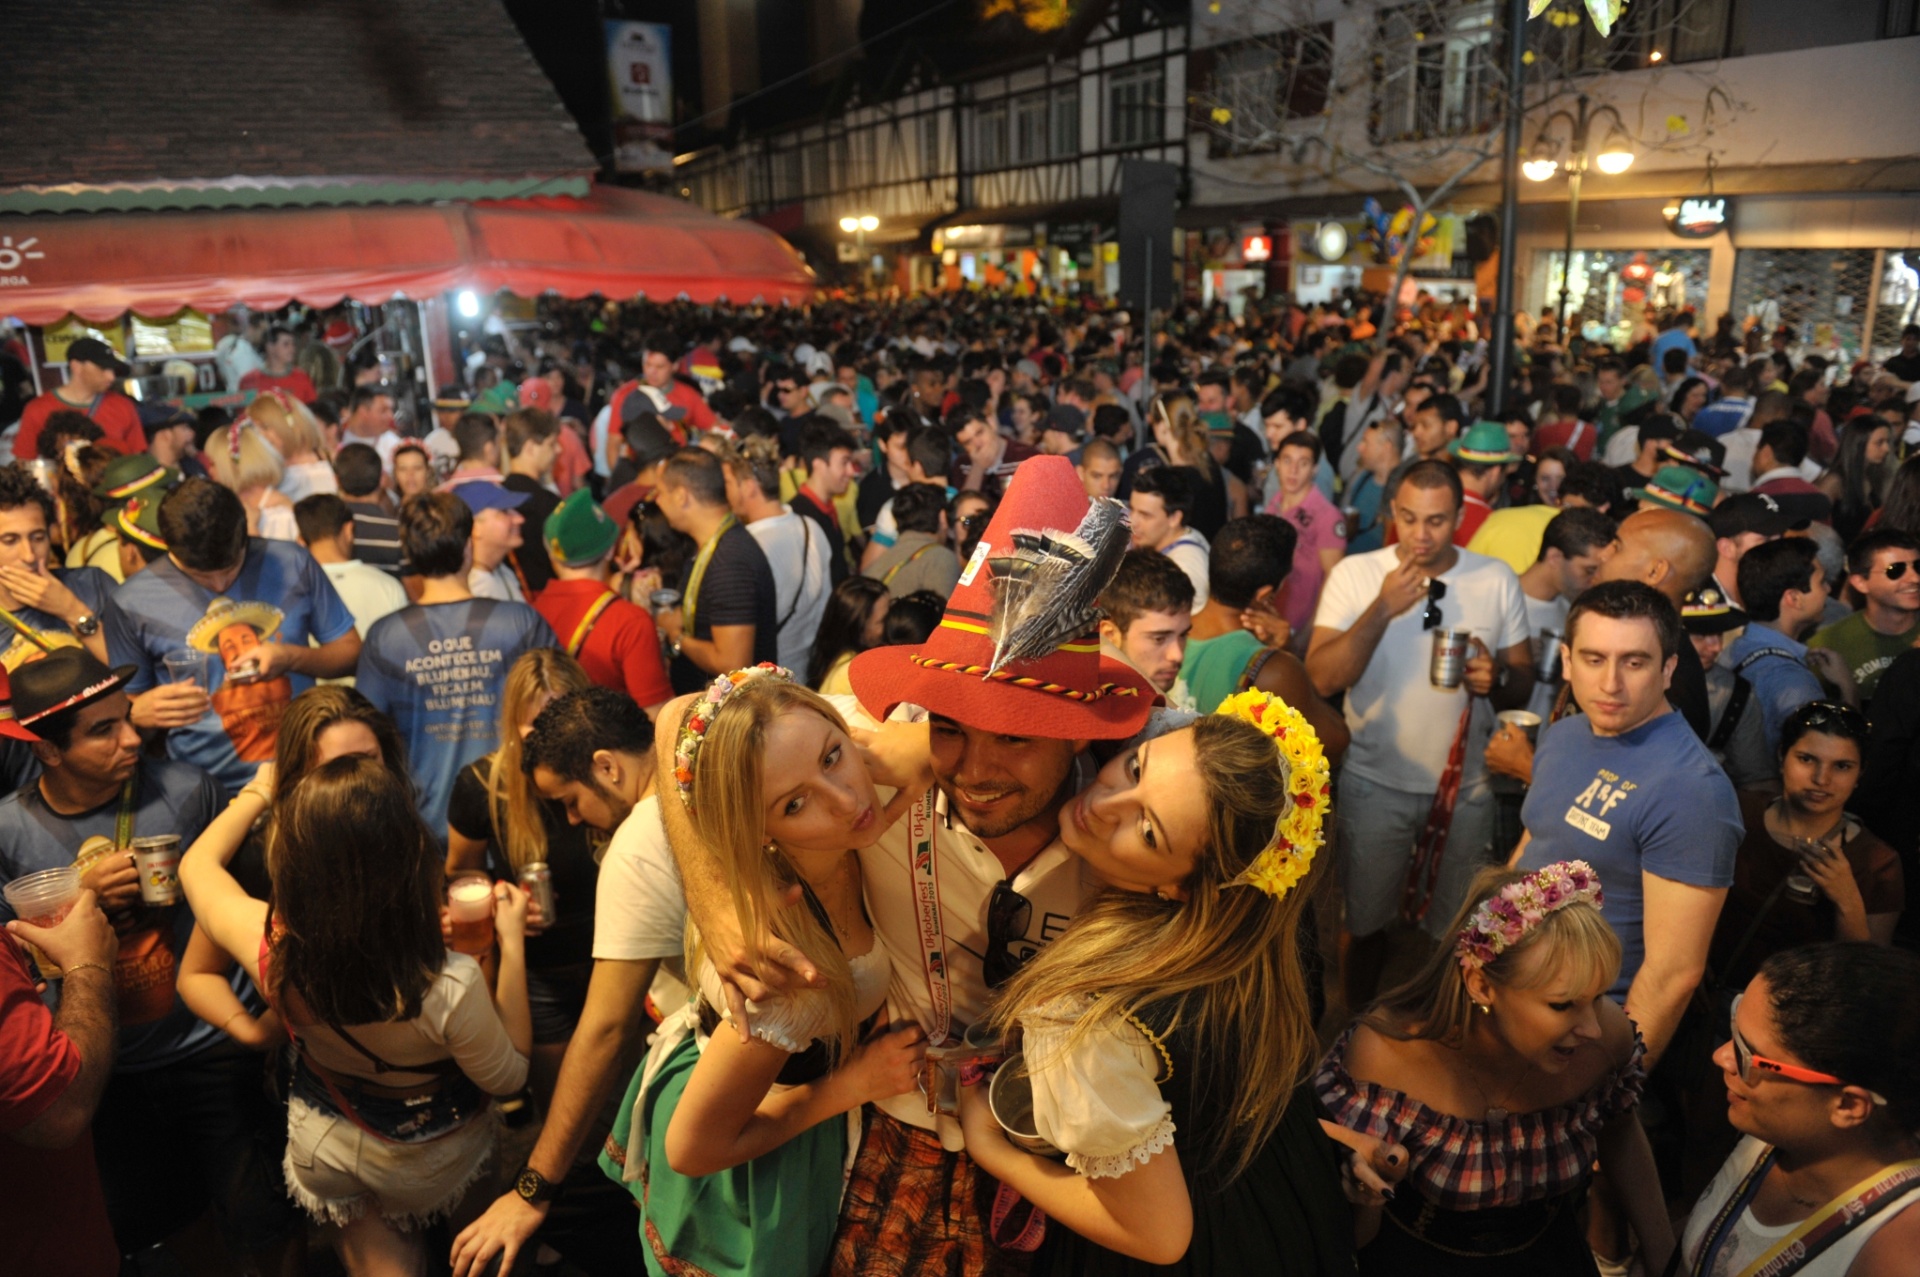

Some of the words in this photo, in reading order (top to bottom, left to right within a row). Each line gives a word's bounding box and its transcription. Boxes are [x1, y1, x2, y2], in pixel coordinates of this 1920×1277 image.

[443, 636, 472, 652] QUE
[405, 651, 477, 673] ACONTECE
[479, 649, 502, 664] EM
[1621, 780, 1638, 791] OF
[1575, 777, 1627, 817] A&F
[928, 881, 936, 900] 2013
[918, 881, 936, 949] Oktoberfest
